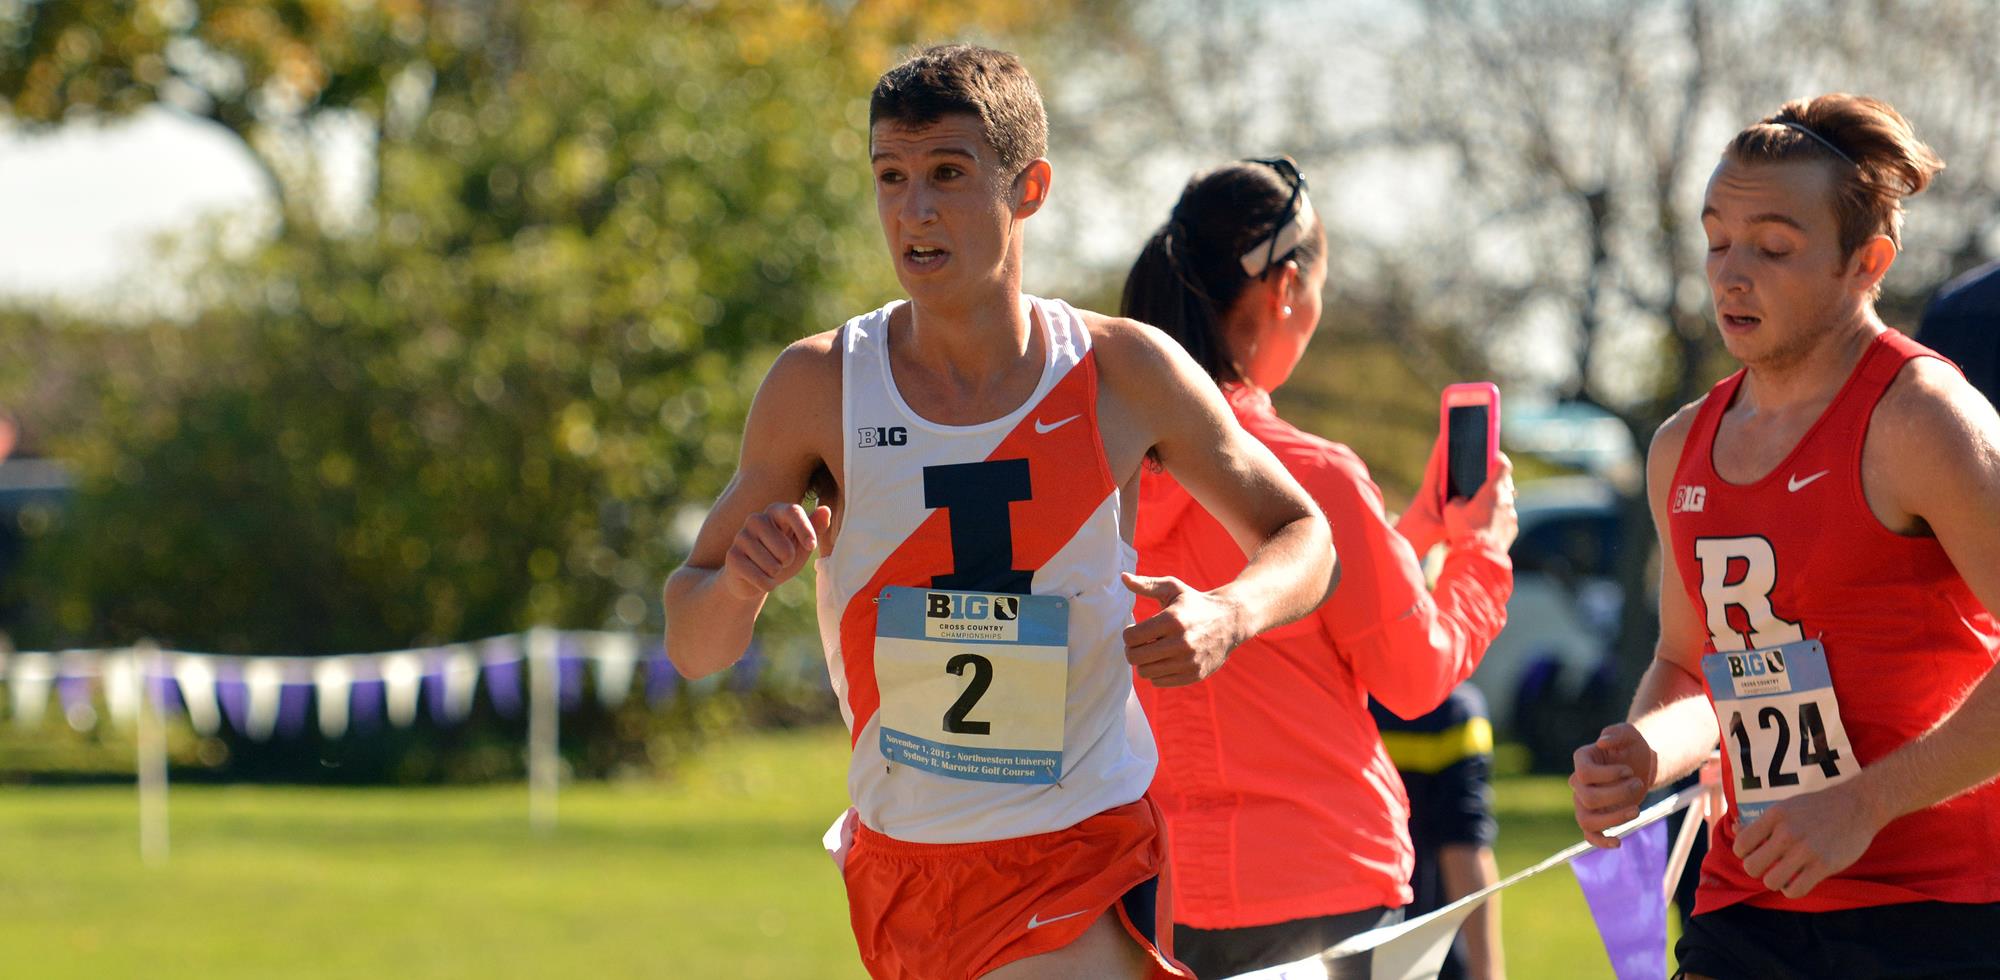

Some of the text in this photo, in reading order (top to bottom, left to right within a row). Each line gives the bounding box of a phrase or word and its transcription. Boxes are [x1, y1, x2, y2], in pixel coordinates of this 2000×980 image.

[923, 458, 1035, 594] I
[1695, 535, 1805, 650] R
[939, 623, 1004, 632] CROSS COUNTRY
[940, 631, 1003, 640] CHAMPIONSHIPS
[942, 653, 993, 735] 2
[885, 734, 920, 751] November
[921, 745, 929, 754] 1,
[930, 748, 950, 760] 2015
[957, 752, 1013, 766] Northwestern
[1015, 758, 1057, 767] University
[903, 750, 1036, 777] Sydney R. Marovitz Golf Course
[1728, 702, 1840, 790] 124
